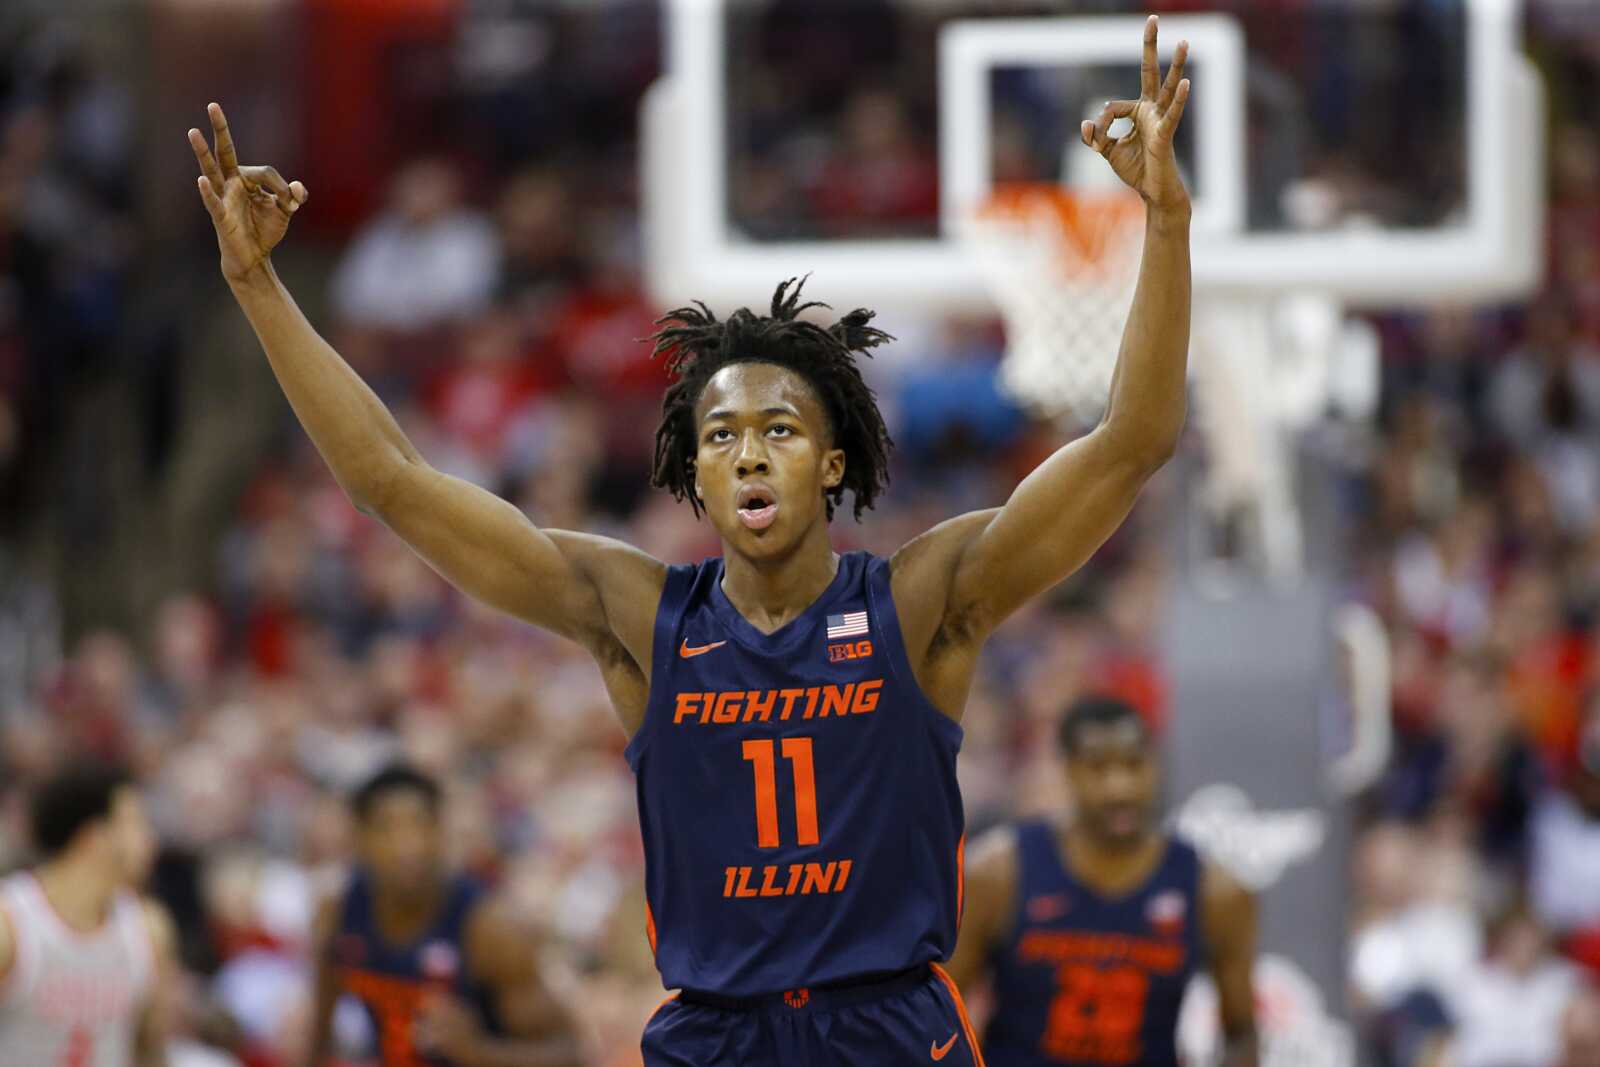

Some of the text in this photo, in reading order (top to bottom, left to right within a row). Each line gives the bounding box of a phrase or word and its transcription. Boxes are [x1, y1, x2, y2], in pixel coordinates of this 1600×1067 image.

[673, 679, 884, 724] FIGHTING
[742, 737, 820, 849] 11
[722, 859, 853, 898] ILLINI
